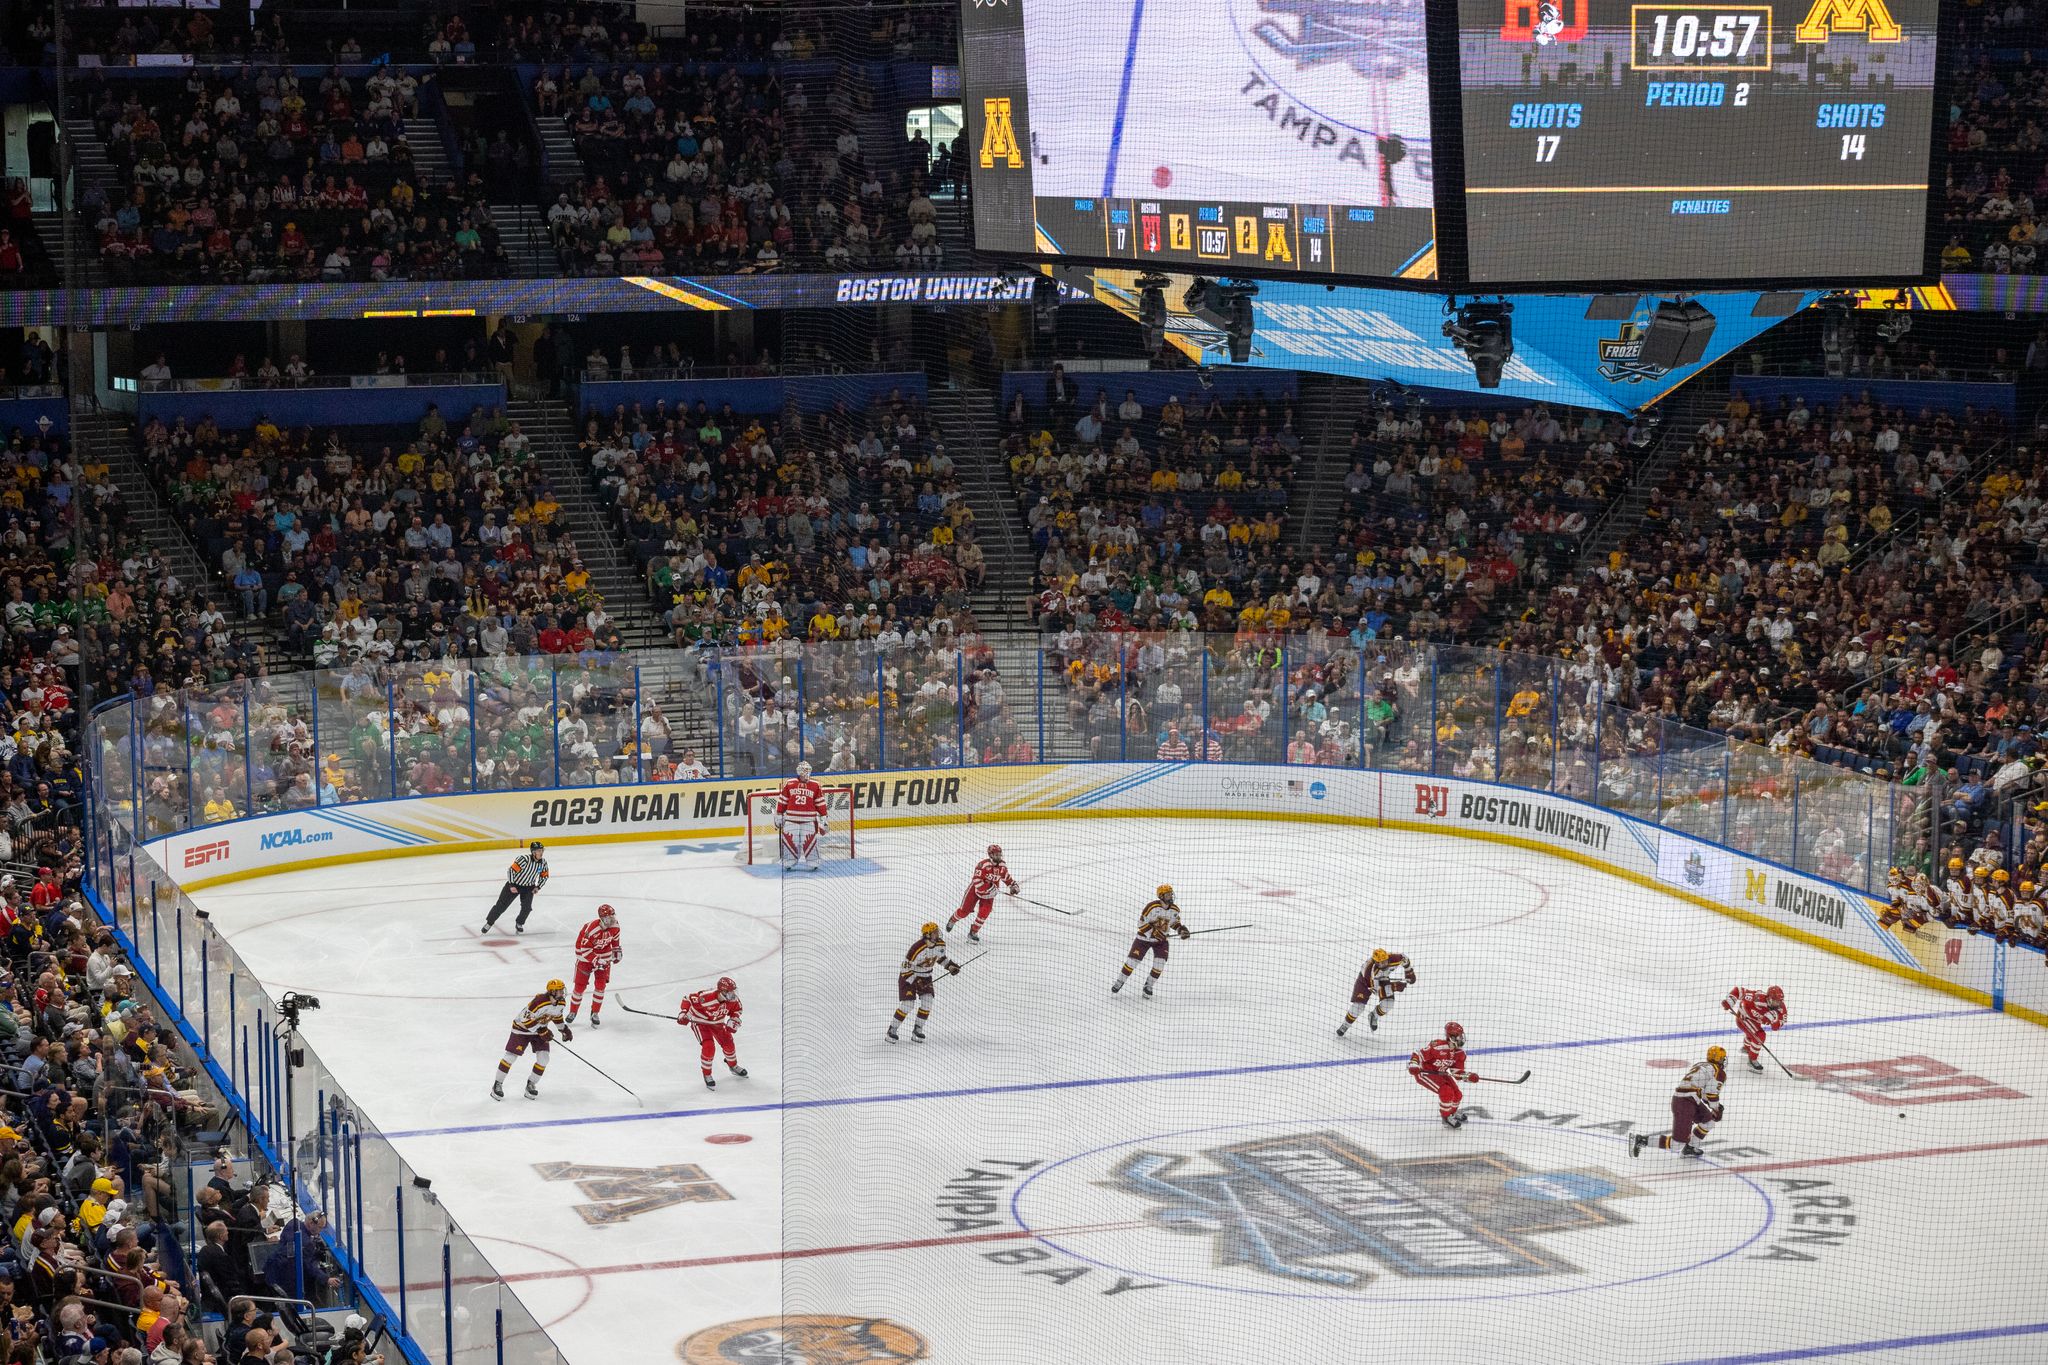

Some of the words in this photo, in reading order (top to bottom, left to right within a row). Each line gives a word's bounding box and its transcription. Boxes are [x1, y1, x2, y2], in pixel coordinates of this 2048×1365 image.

[1653, 16, 1760, 58] 10:57
[1646, 83, 1725, 107] PERIOD
[1733, 83, 1749, 107] 2
[1241, 71, 1367, 169] TAMPA
[1509, 103, 1582, 128] SHOTS
[1817, 104, 1886, 128] SHOTS
[1536, 136, 1561, 163] 17
[1840, 135, 1866, 161] 14
[1111, 210, 1129, 225] SHOTS
[1199, 207, 1217, 221] PERIOD
[1218, 205, 1223, 223] 2
[1263, 207, 1288, 219] MINNESOTA
[1671, 200, 1730, 215] PENALTIES
[1176, 218, 1184, 246] 2
[1243, 220, 1251, 249] 2
[1303, 217, 1325, 233] SHOTS
[1117, 228, 1126, 250] 17
[1201, 231, 1226, 254] 10:57
[1310, 238, 1322, 262] 14
[837, 279, 919, 301] BOSTON
[925, 277, 1036, 299] UNIVERSIT
[1604, 345, 1641, 358] FROZE
[789, 787, 815, 799] BOSTON
[1221, 776, 1283, 791] Olympians
[530, 797, 604, 828] 2023
[611, 793, 680, 822] NCAA
[892, 777, 961, 807] FOUR
[795, 795, 807, 804] 29
[1460, 793, 1531, 829] BOSTON
[1535, 806, 1611, 850] UNIVERSITY
[260, 828, 333, 850] NCAA.com
[185, 840, 230, 868] ESPN
[1775, 880, 1846, 929] MICHIGAN
[936, 1159, 1044, 1233] TAMPA
[1747, 1177, 1857, 1263] ARENA
[980, 1247, 1168, 1296] BAY
